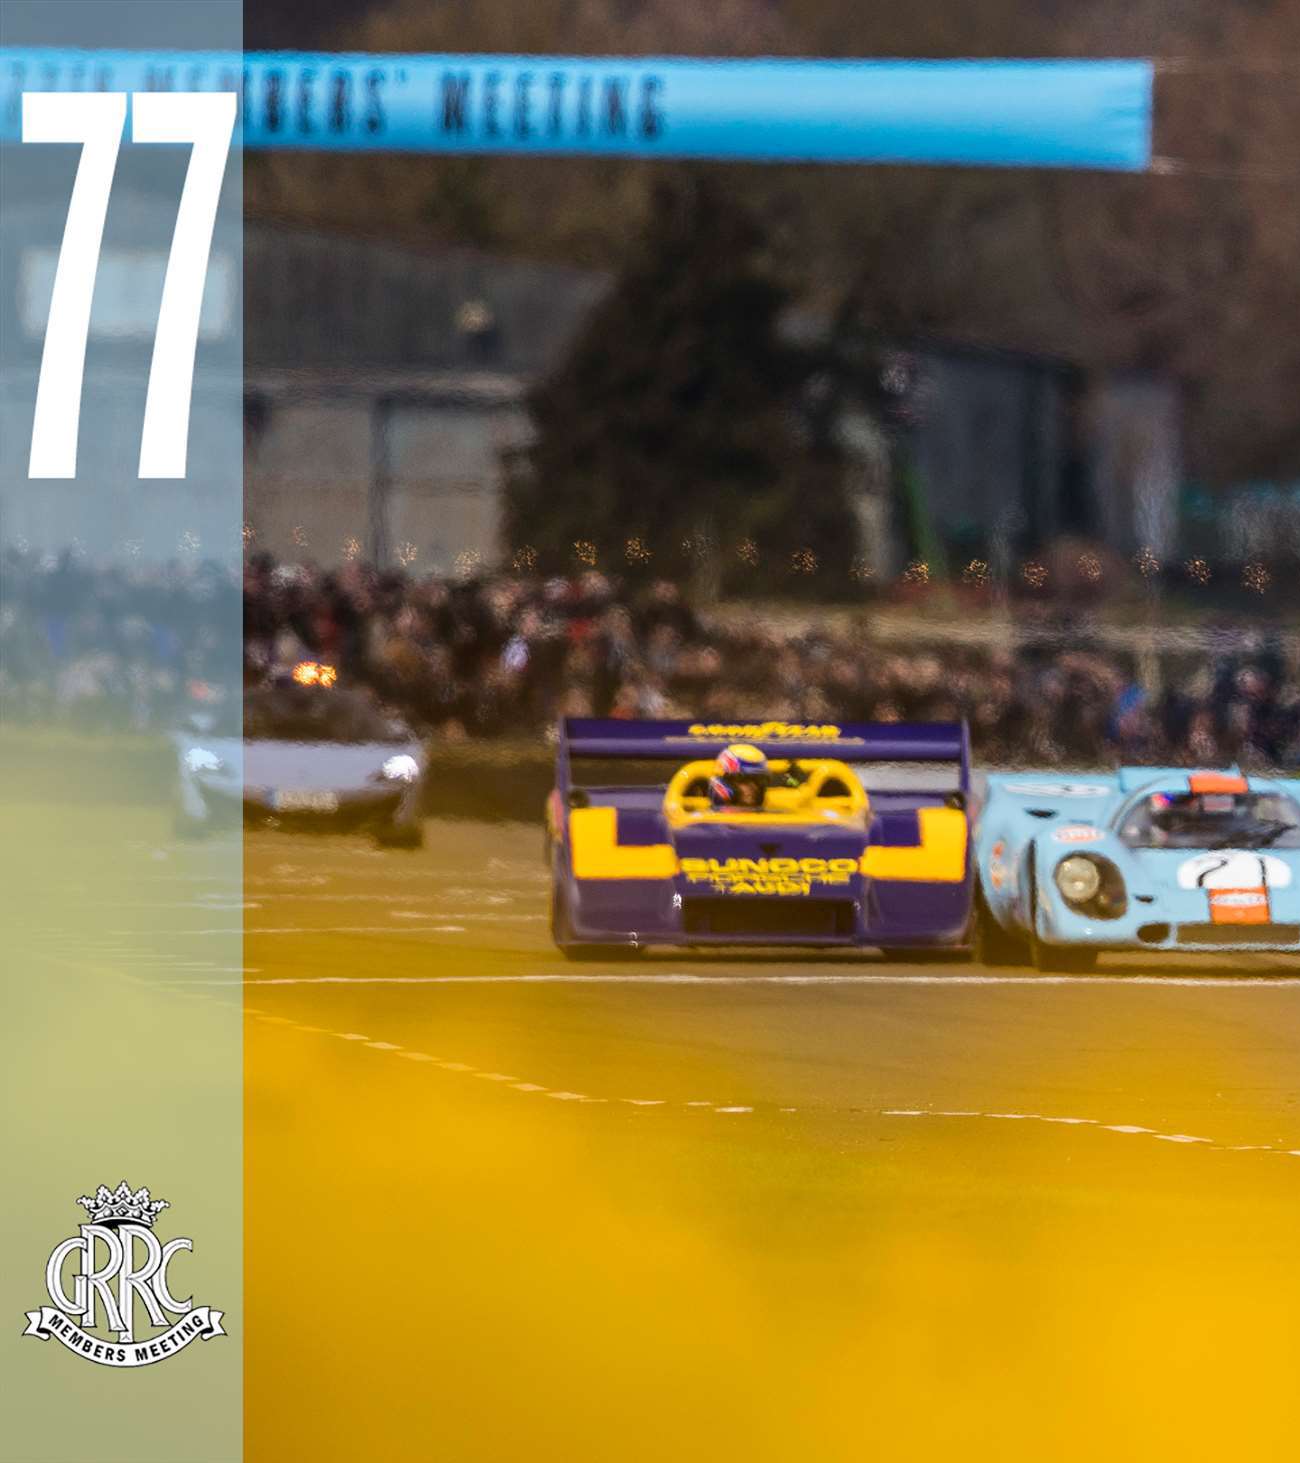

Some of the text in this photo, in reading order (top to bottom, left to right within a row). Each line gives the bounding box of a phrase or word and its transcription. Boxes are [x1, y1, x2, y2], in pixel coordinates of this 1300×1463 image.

[441, 69, 668, 141] MEETING
[680, 858, 858, 873] SUNOCO
[686, 870, 851, 885] PORSCHE
